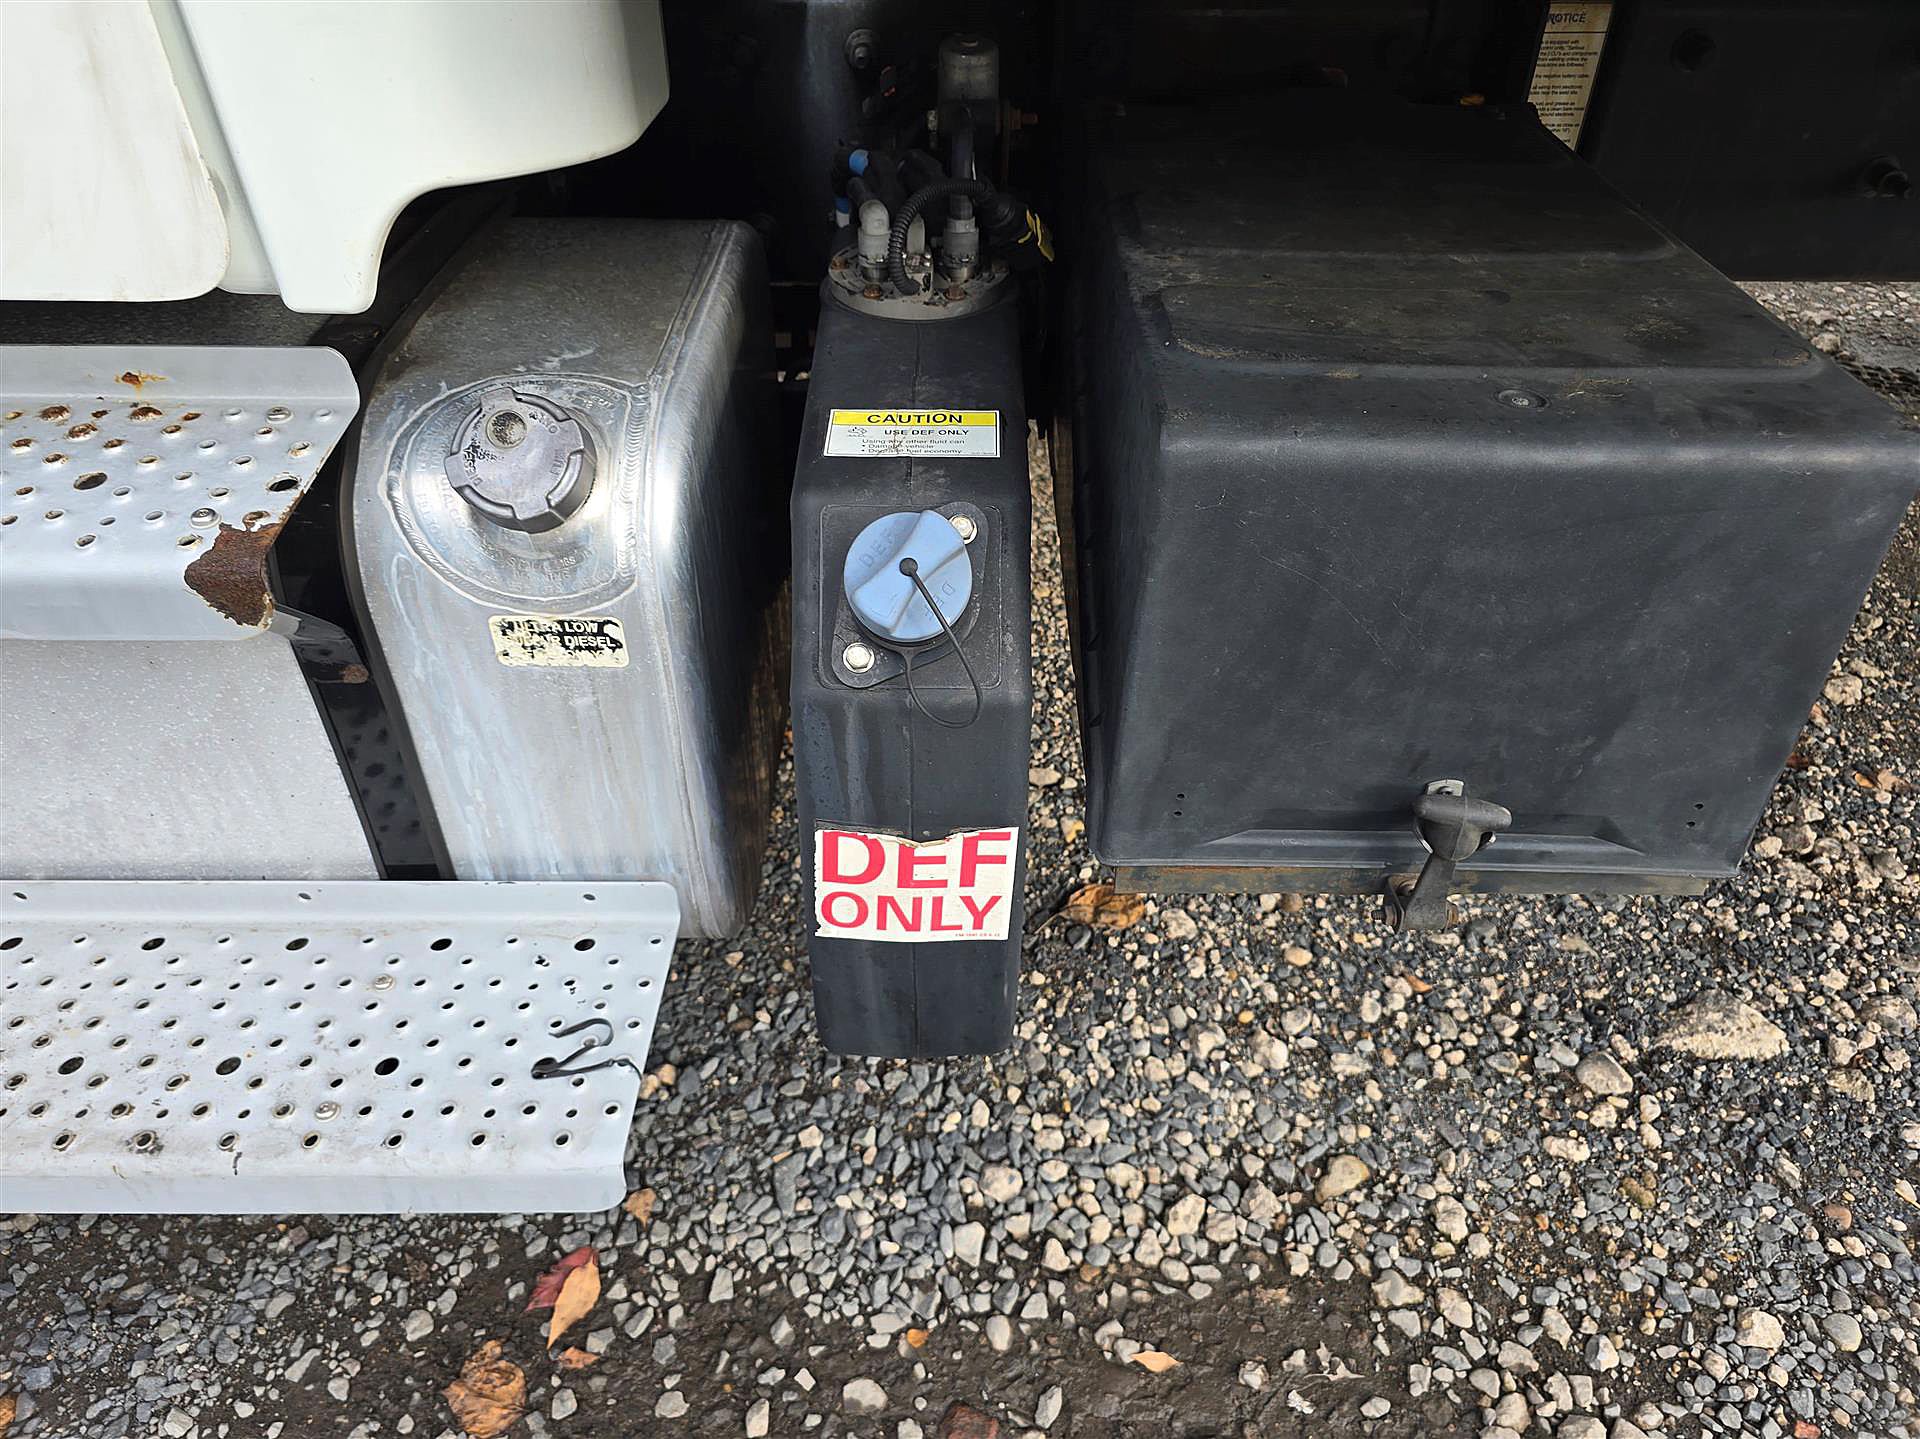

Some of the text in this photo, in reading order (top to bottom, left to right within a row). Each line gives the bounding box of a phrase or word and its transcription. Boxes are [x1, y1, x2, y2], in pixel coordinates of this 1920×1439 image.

[1547, 12, 1586, 24] NOTICE
[867, 413, 962, 424] CAUTION
[565, 621, 598, 634] LOW
[565, 635, 616, 647] DIESEL
[822, 830, 1011, 888] DEF
[821, 891, 1003, 932] ONLY
